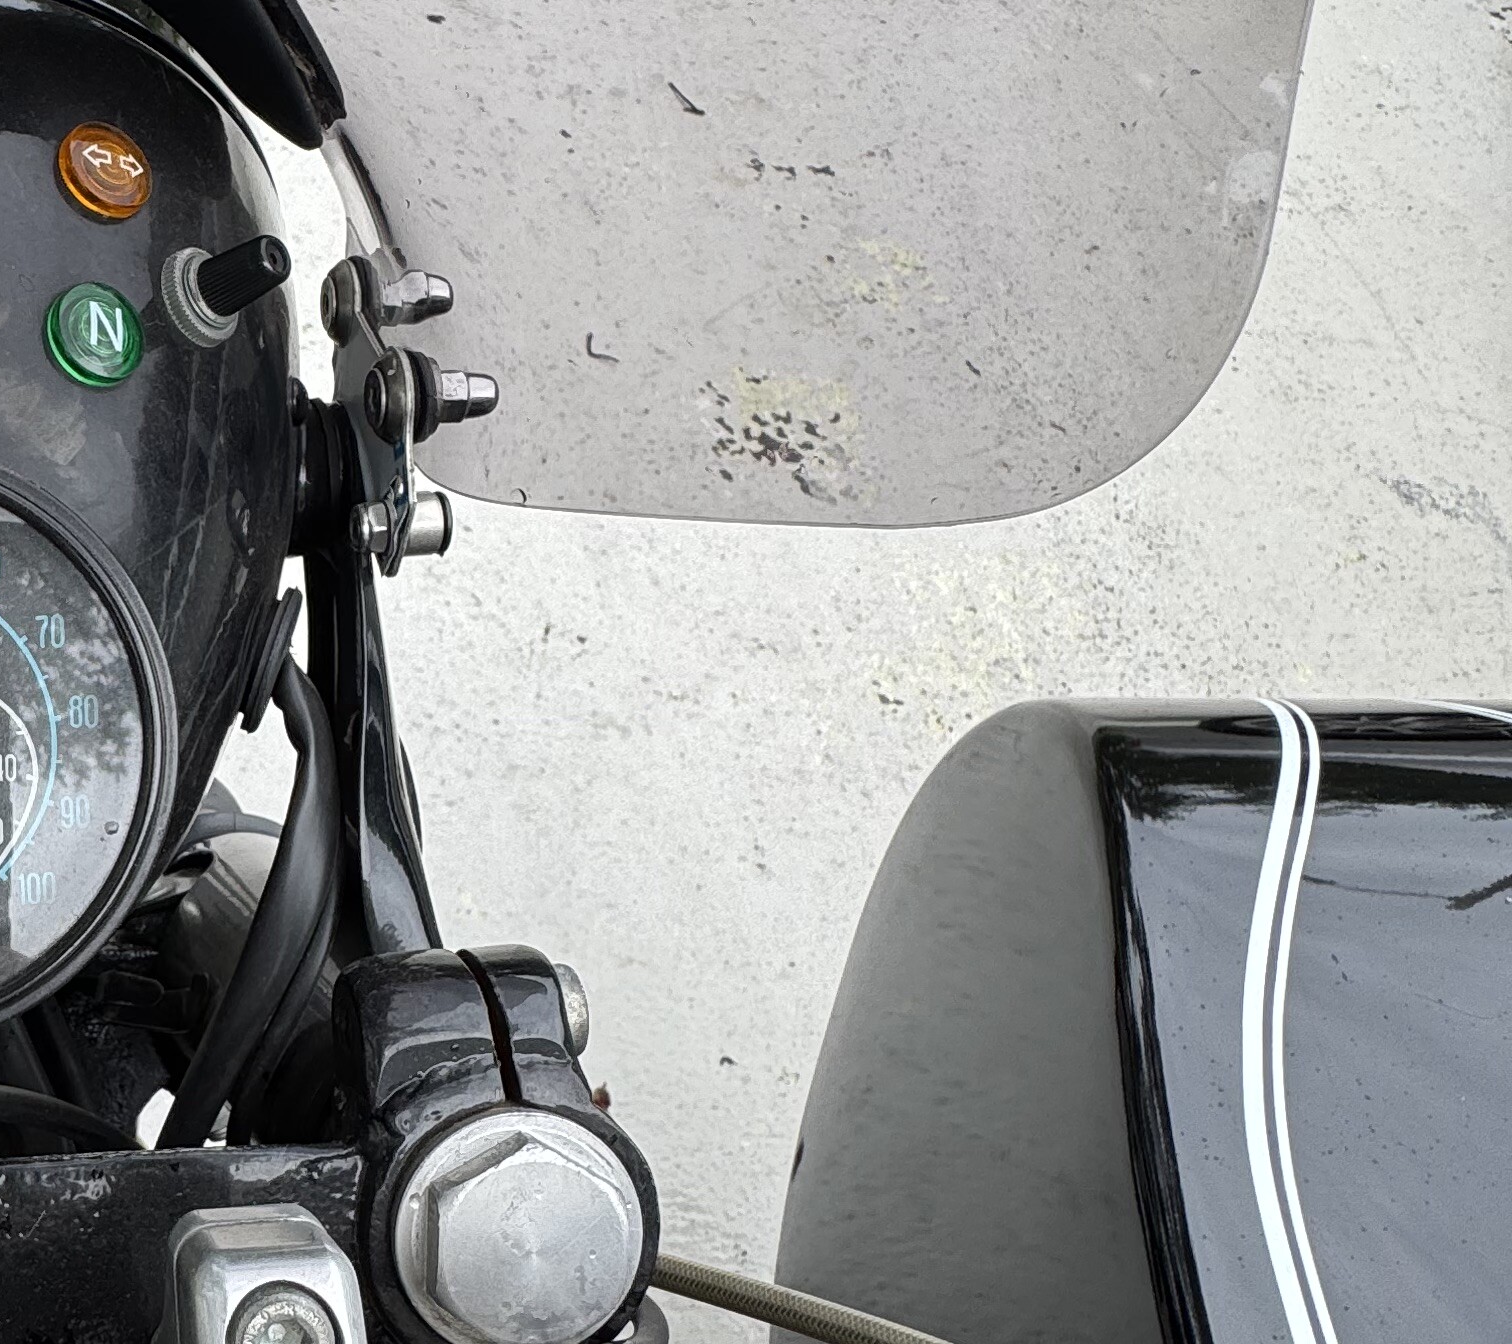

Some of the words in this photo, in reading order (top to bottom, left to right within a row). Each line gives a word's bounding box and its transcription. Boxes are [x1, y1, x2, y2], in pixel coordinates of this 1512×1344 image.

[89, 301, 123, 352] N
[35, 613, 65, 648] 70
[68, 694, 100, 729] 80
[60, 796, 92, 829] 90
[20, 871, 57, 905] 100
